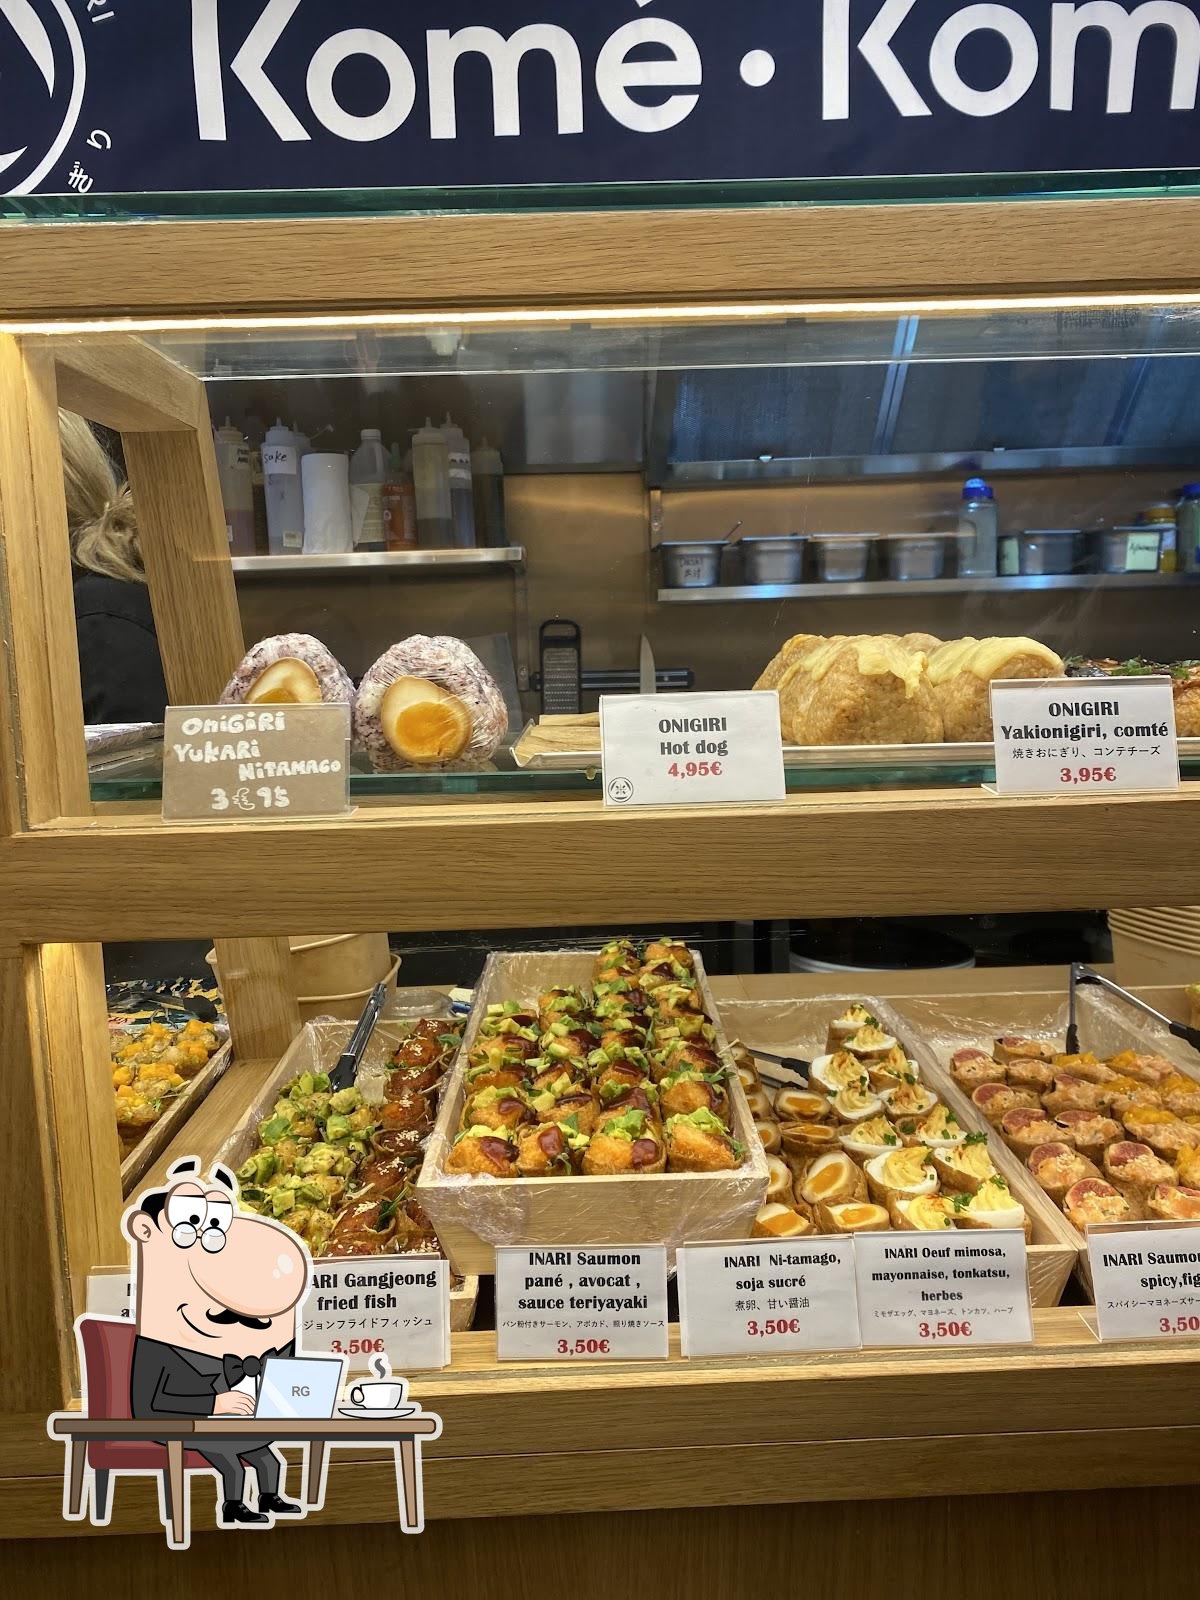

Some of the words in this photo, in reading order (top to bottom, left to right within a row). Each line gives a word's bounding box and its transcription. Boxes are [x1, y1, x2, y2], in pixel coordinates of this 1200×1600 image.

[1048, 701, 1120, 717] ONIGIRI
[658, 717, 728, 734] ONIGIRI
[1001, 724, 1107, 742] Yakionigiri,
[1113, 722, 1169, 738] comté
[660, 741, 690, 755] Hot
[695, 740, 729, 757] dog
[668, 761, 723, 779] 4,95€
[1060, 767, 1117, 784] 3,95€
[529, 1252, 571, 1266] INARI
[577, 1252, 641, 1266] Saumon
[724, 1255, 761, 1268] INARI
[769, 1252, 841, 1266] Ni-tamago,
[885, 1247, 918, 1259] INARI
[922, 1247, 951, 1258] Oeuf
[954, 1246, 1006, 1258] mimosa,
[1103, 1253, 1143, 1266] INARI
[344, 1270, 437, 1290] Gangjeong
[525, 1274, 563, 1290] pané
[578, 1274, 631, 1288] avocat
[736, 1278, 765, 1291] soja
[768, 1275, 806, 1289] sucré
[872, 1269, 949, 1282] mayonnaise,
[952, 1267, 1010, 1280] tonkatsu,
[317, 1295, 359, 1311] fried
[363, 1293, 397, 1309] fish
[518, 1298, 565, 1310] sauce
[570, 1295, 648, 1312] teriyayaki
[921, 1290, 963, 1301] herbes
[747, 1318, 801, 1338] 3,50€
[919, 1321, 972, 1339] 3,50€
[331, 1338, 385, 1355] 3,50€
[557, 1339, 611, 1356] 3,50€
